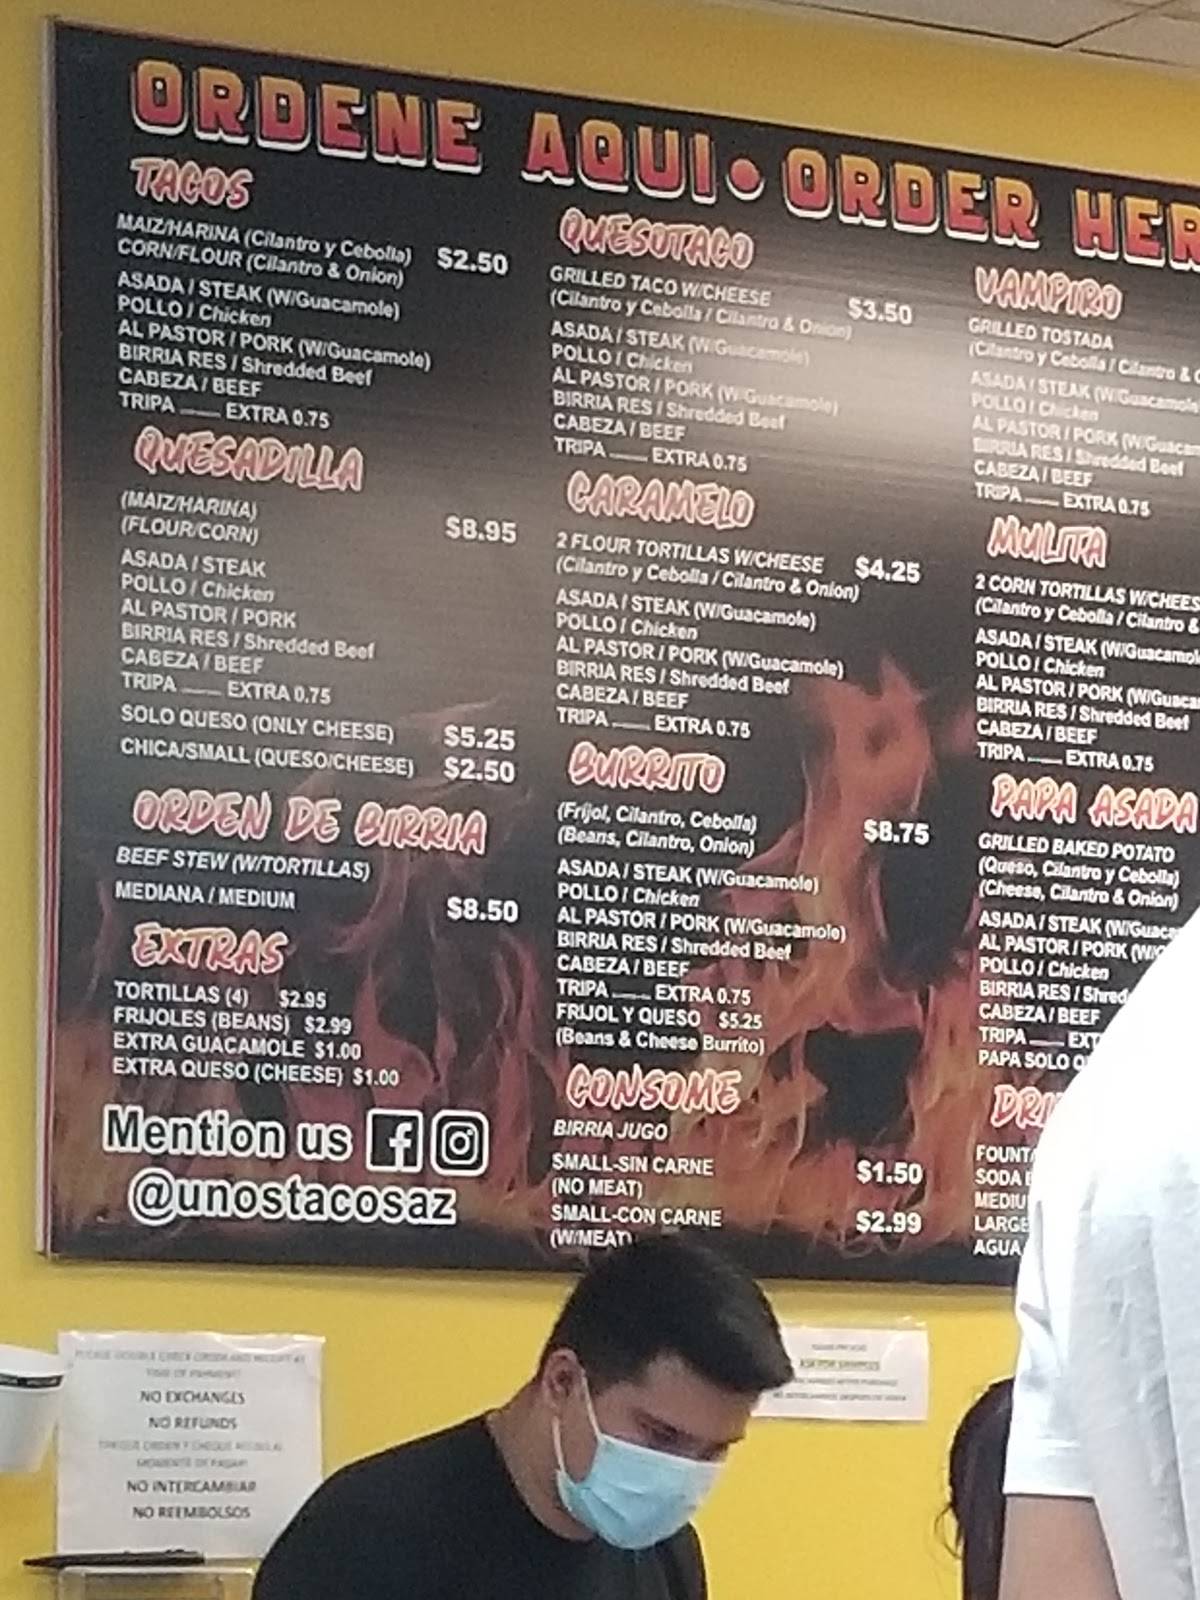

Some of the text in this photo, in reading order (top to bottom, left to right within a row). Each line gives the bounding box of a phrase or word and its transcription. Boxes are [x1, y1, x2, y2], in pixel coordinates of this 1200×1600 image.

[132, 59, 483, 174] ORDENE
[522, 112, 716, 203] AQUI
[783, 147, 1040, 250] ORDER
[130, 157, 254, 208] TACOS
[117, 214, 508, 275] MAIZ/HARINA (Cilantro y Cebolla) $2.50
[560, 207, 754, 269] QUESOTACO
[118, 238, 404, 291] CORN/FLOUR (Cilantro & Onion)
[118, 272, 400, 321] ASADA STEAK (W/Guacamole)
[118, 295, 271, 327] POLLO Chicken
[550, 265, 912, 324] GRILLED TACO W/CHEESE $3.50
[975, 266, 1122, 320] VAMPIRO
[118, 320, 430, 373] AL PASTOR PORK (W/Guacamole)
[969, 317, 1113, 350] GRILLED TOSTADA
[119, 343, 372, 386] BIRRIA RES Shredded Beef
[119, 367, 263, 399] CABEZA BEEF
[119, 392, 330, 429] TRIPA EXTRA 0.75
[135, 426, 363, 492] QUESADILLA
[120, 491, 257, 521] (MAIZ/HARINA)
[568, 470, 754, 529] CARAMELO
[121, 515, 517, 546] (FLOUR/CORN) $8.95
[987, 516, 1106, 568] MULITA
[556, 532, 920, 583] 2 FLOUR TORTILLAS W/CHEESE $4.25
[975, 574, 1125, 604] 2 CORN TORTILLAS
[121, 672, 331, 704] TRIPA EXTRA 0.75
[121, 705, 516, 751] SOLO QUESO (ONLY CHEESE) $5.25
[121, 738, 515, 783] CHICA/SMALL (QUESO/CHEESE) $2.50
[569, 742, 725, 793] BURRITO
[991, 773, 1198, 833] PAPA ASADA
[133, 789, 487, 856] ORDEN DE BIRRIA
[558, 802, 930, 845] (Frijol, Cilantro, Cebolla) $8.75
[558, 826, 754, 859] (Beans, Cilantro, Onion)
[979, 833, 1175, 863] GRILLED BAKED POTATO
[116, 846, 370, 882] BEEF STEW (W/TORTILLAS)
[557, 859, 819, 895] ASADA STEAK (W/Guacamole)
[116, 882, 518, 923] MEDIANA MEDIUM $8.50
[558, 883, 700, 907] POLLO Chicken
[557, 907, 846, 944] AL PASTOR PORK (W/Guacamole)
[132, 921, 289, 975] EXTRAS
[557, 931, 792, 961] BIRRIA RES Shredded Beef
[557, 955, 689, 978] CABEZA BEEF
[114, 981, 326, 1009] TORTILLAS (4) $2.95
[114, 1007, 351, 1034] FRIJOLES (BEANS) $2.99
[556, 1003, 763, 1029] FRIJOL Y QUESO $5.25
[114, 1032, 362, 1060] EXTRA GUACAMOLE $1.00
[556, 1028, 764, 1057] (Beans & Cheese Burrito)
[113, 1058, 399, 1087] EXTRA QUESO (CHEESE) $1.00
[566, 1064, 741, 1114] CONSOME
[103, 1104, 353, 1161] Mention us
[554, 1120, 668, 1140] BIRRIA JUGO
[552, 1153, 923, 1184] SMALL-SIN CARNE $1.50
[975, 1168, 1022, 1186] SODA
[128, 1167, 456, 1226] @unostacosaz
[552, 1178, 642, 1200] (NO MEAT)
[551, 1205, 922, 1234] SMALL-CON CARNE $2.99
[973, 1240, 1022, 1255] AGUA
[140, 1390, 246, 1405] NO EXCHANGES
[148, 1417, 238, 1430] NO REFUNDS
[127, 1480, 148, 1493] NO
[132, 1506, 154, 1518] NO
